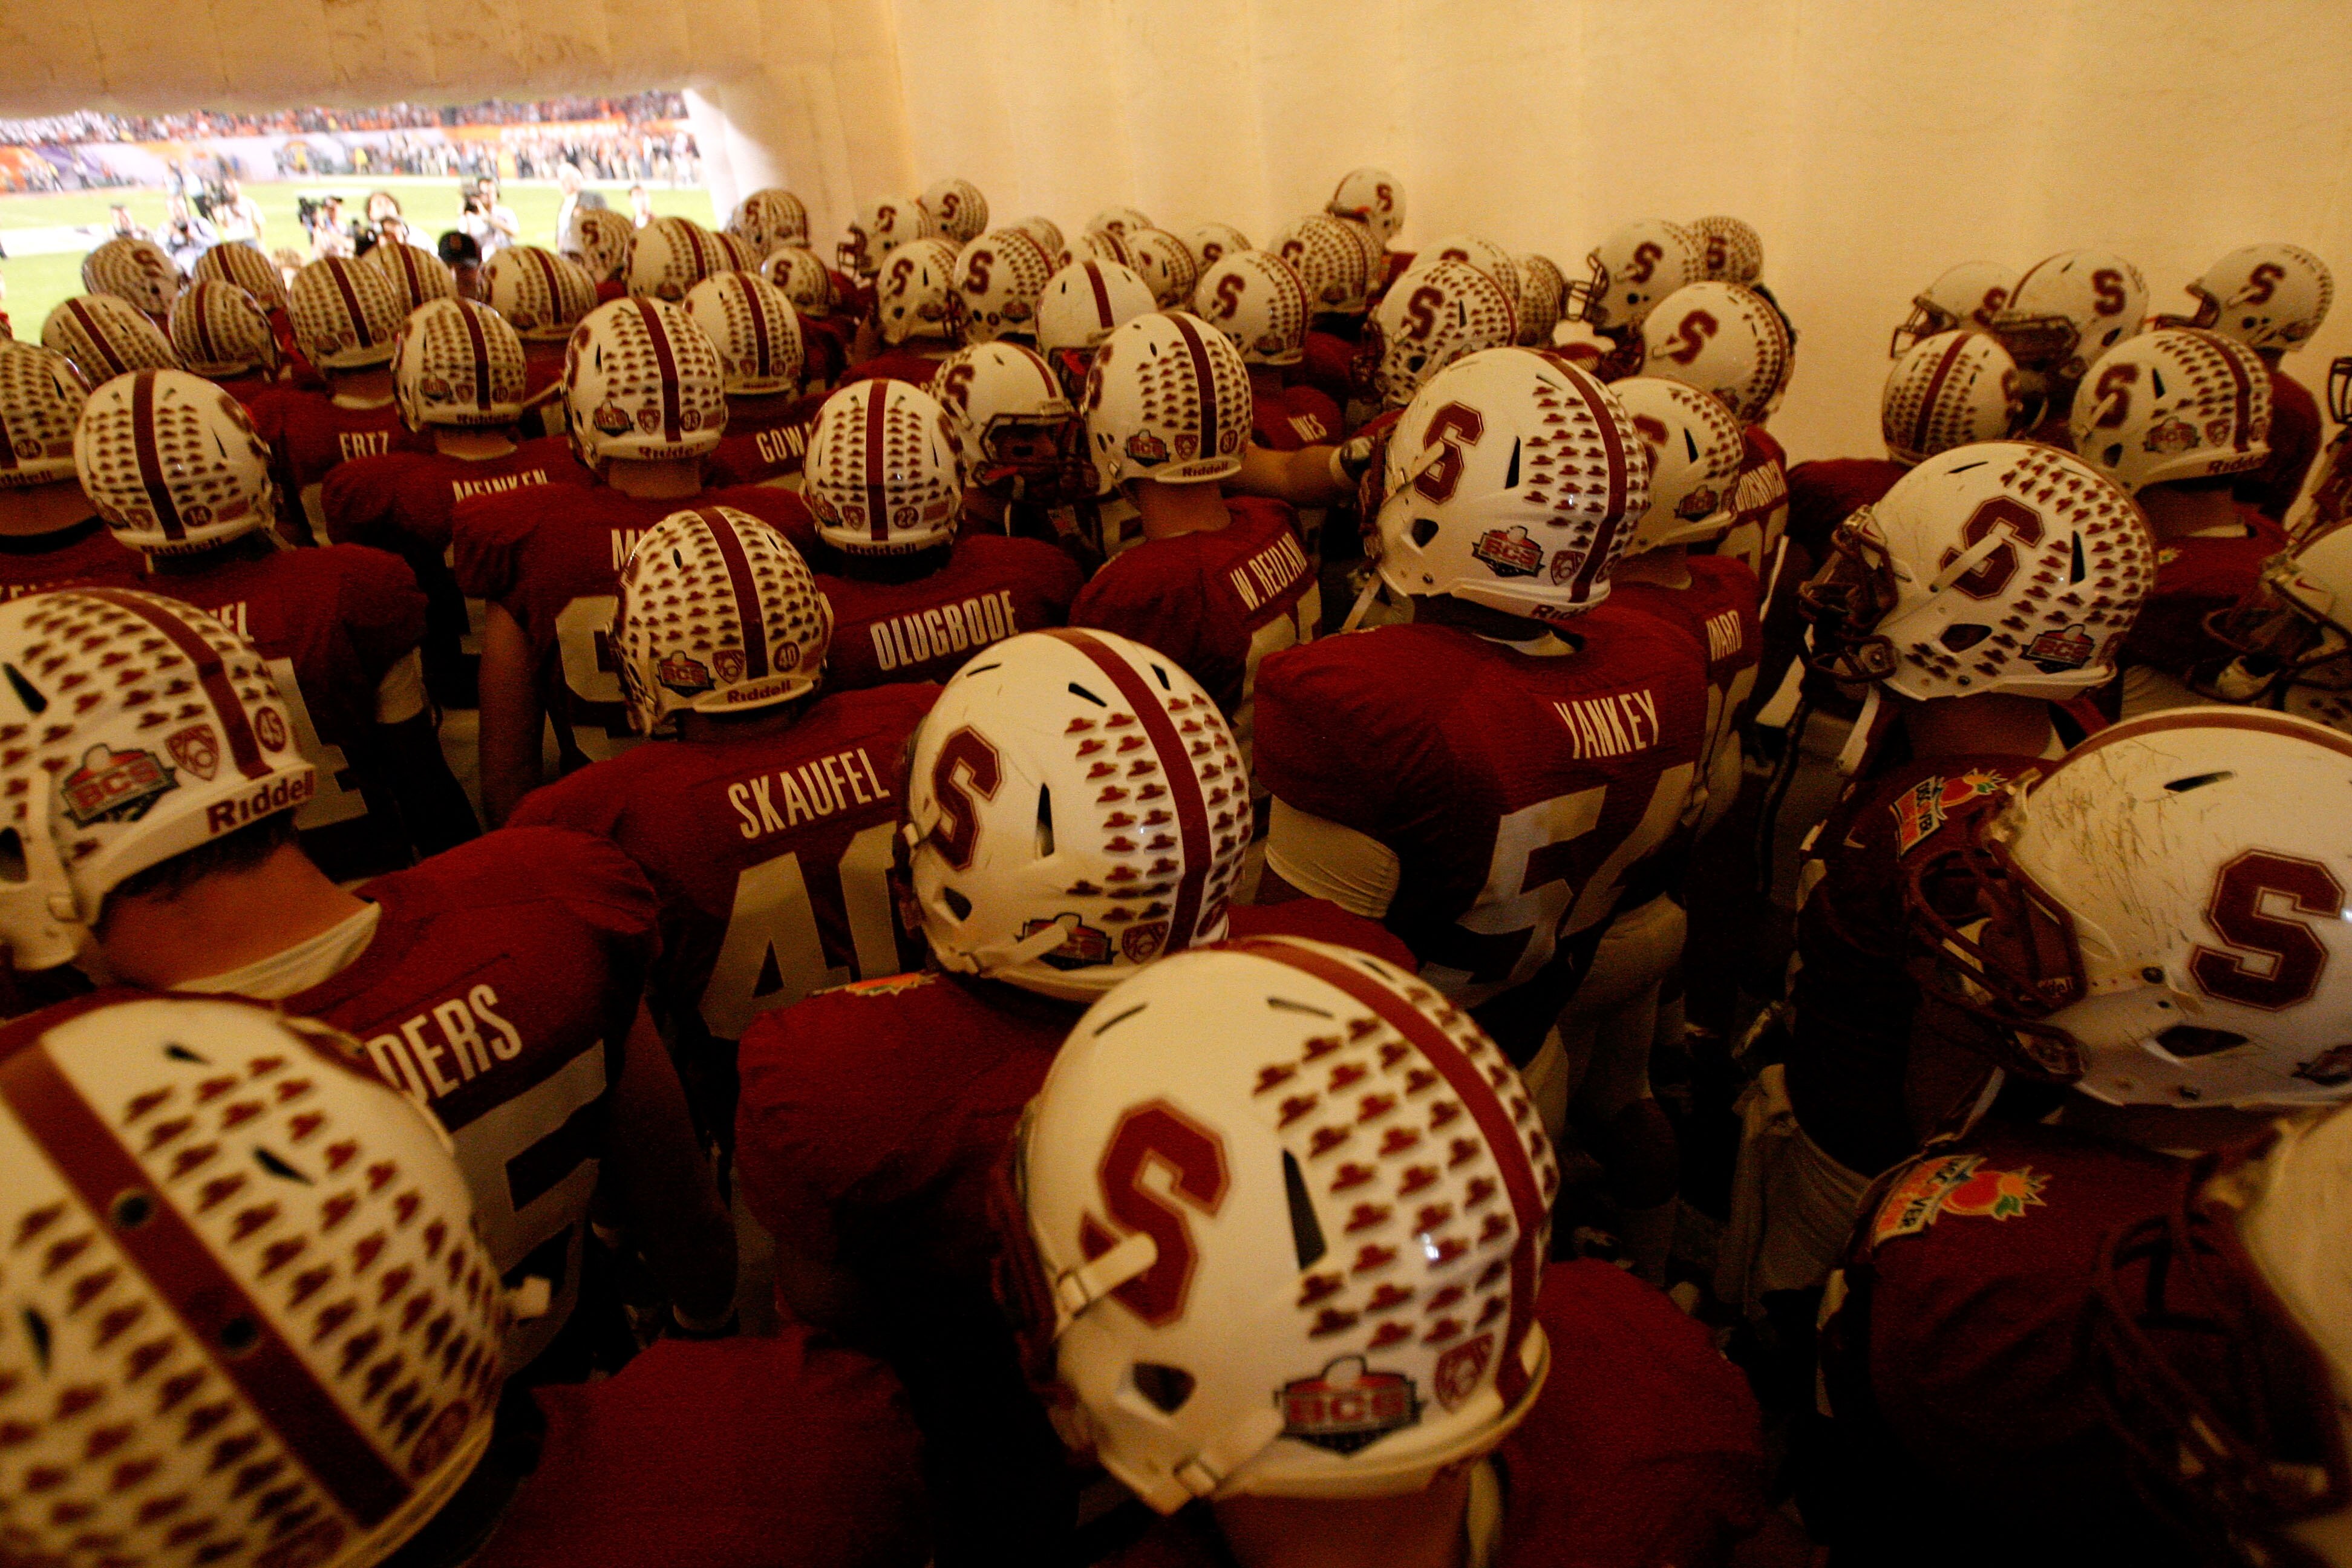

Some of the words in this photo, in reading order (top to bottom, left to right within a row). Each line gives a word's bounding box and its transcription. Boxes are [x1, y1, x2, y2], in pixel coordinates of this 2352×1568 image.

[1376, 184, 1394, 212] S
[889, 258, 913, 296] S
[969, 250, 993, 295] S
[1632, 242, 1664, 284] S
[2249, 262, 2284, 304] S
[1213, 273, 1246, 318] S
[1406, 286, 1445, 341] S
[2092, 268, 2126, 316] S
[1669, 309, 1719, 364] S
[2097, 364, 2139, 428] S
[1413, 400, 1485, 505] S
[1939, 496, 2045, 600] S
[727, 680, 792, 704] Riddell
[1553, 688, 1660, 760] YANKEY
[207, 771, 315, 834] Riddell
[728, 748, 891, 840] SKAUFEL
[932, 726, 1002, 872] S
[2190, 849, 2347, 1013] S
[1079, 1098, 1230, 1328] S
